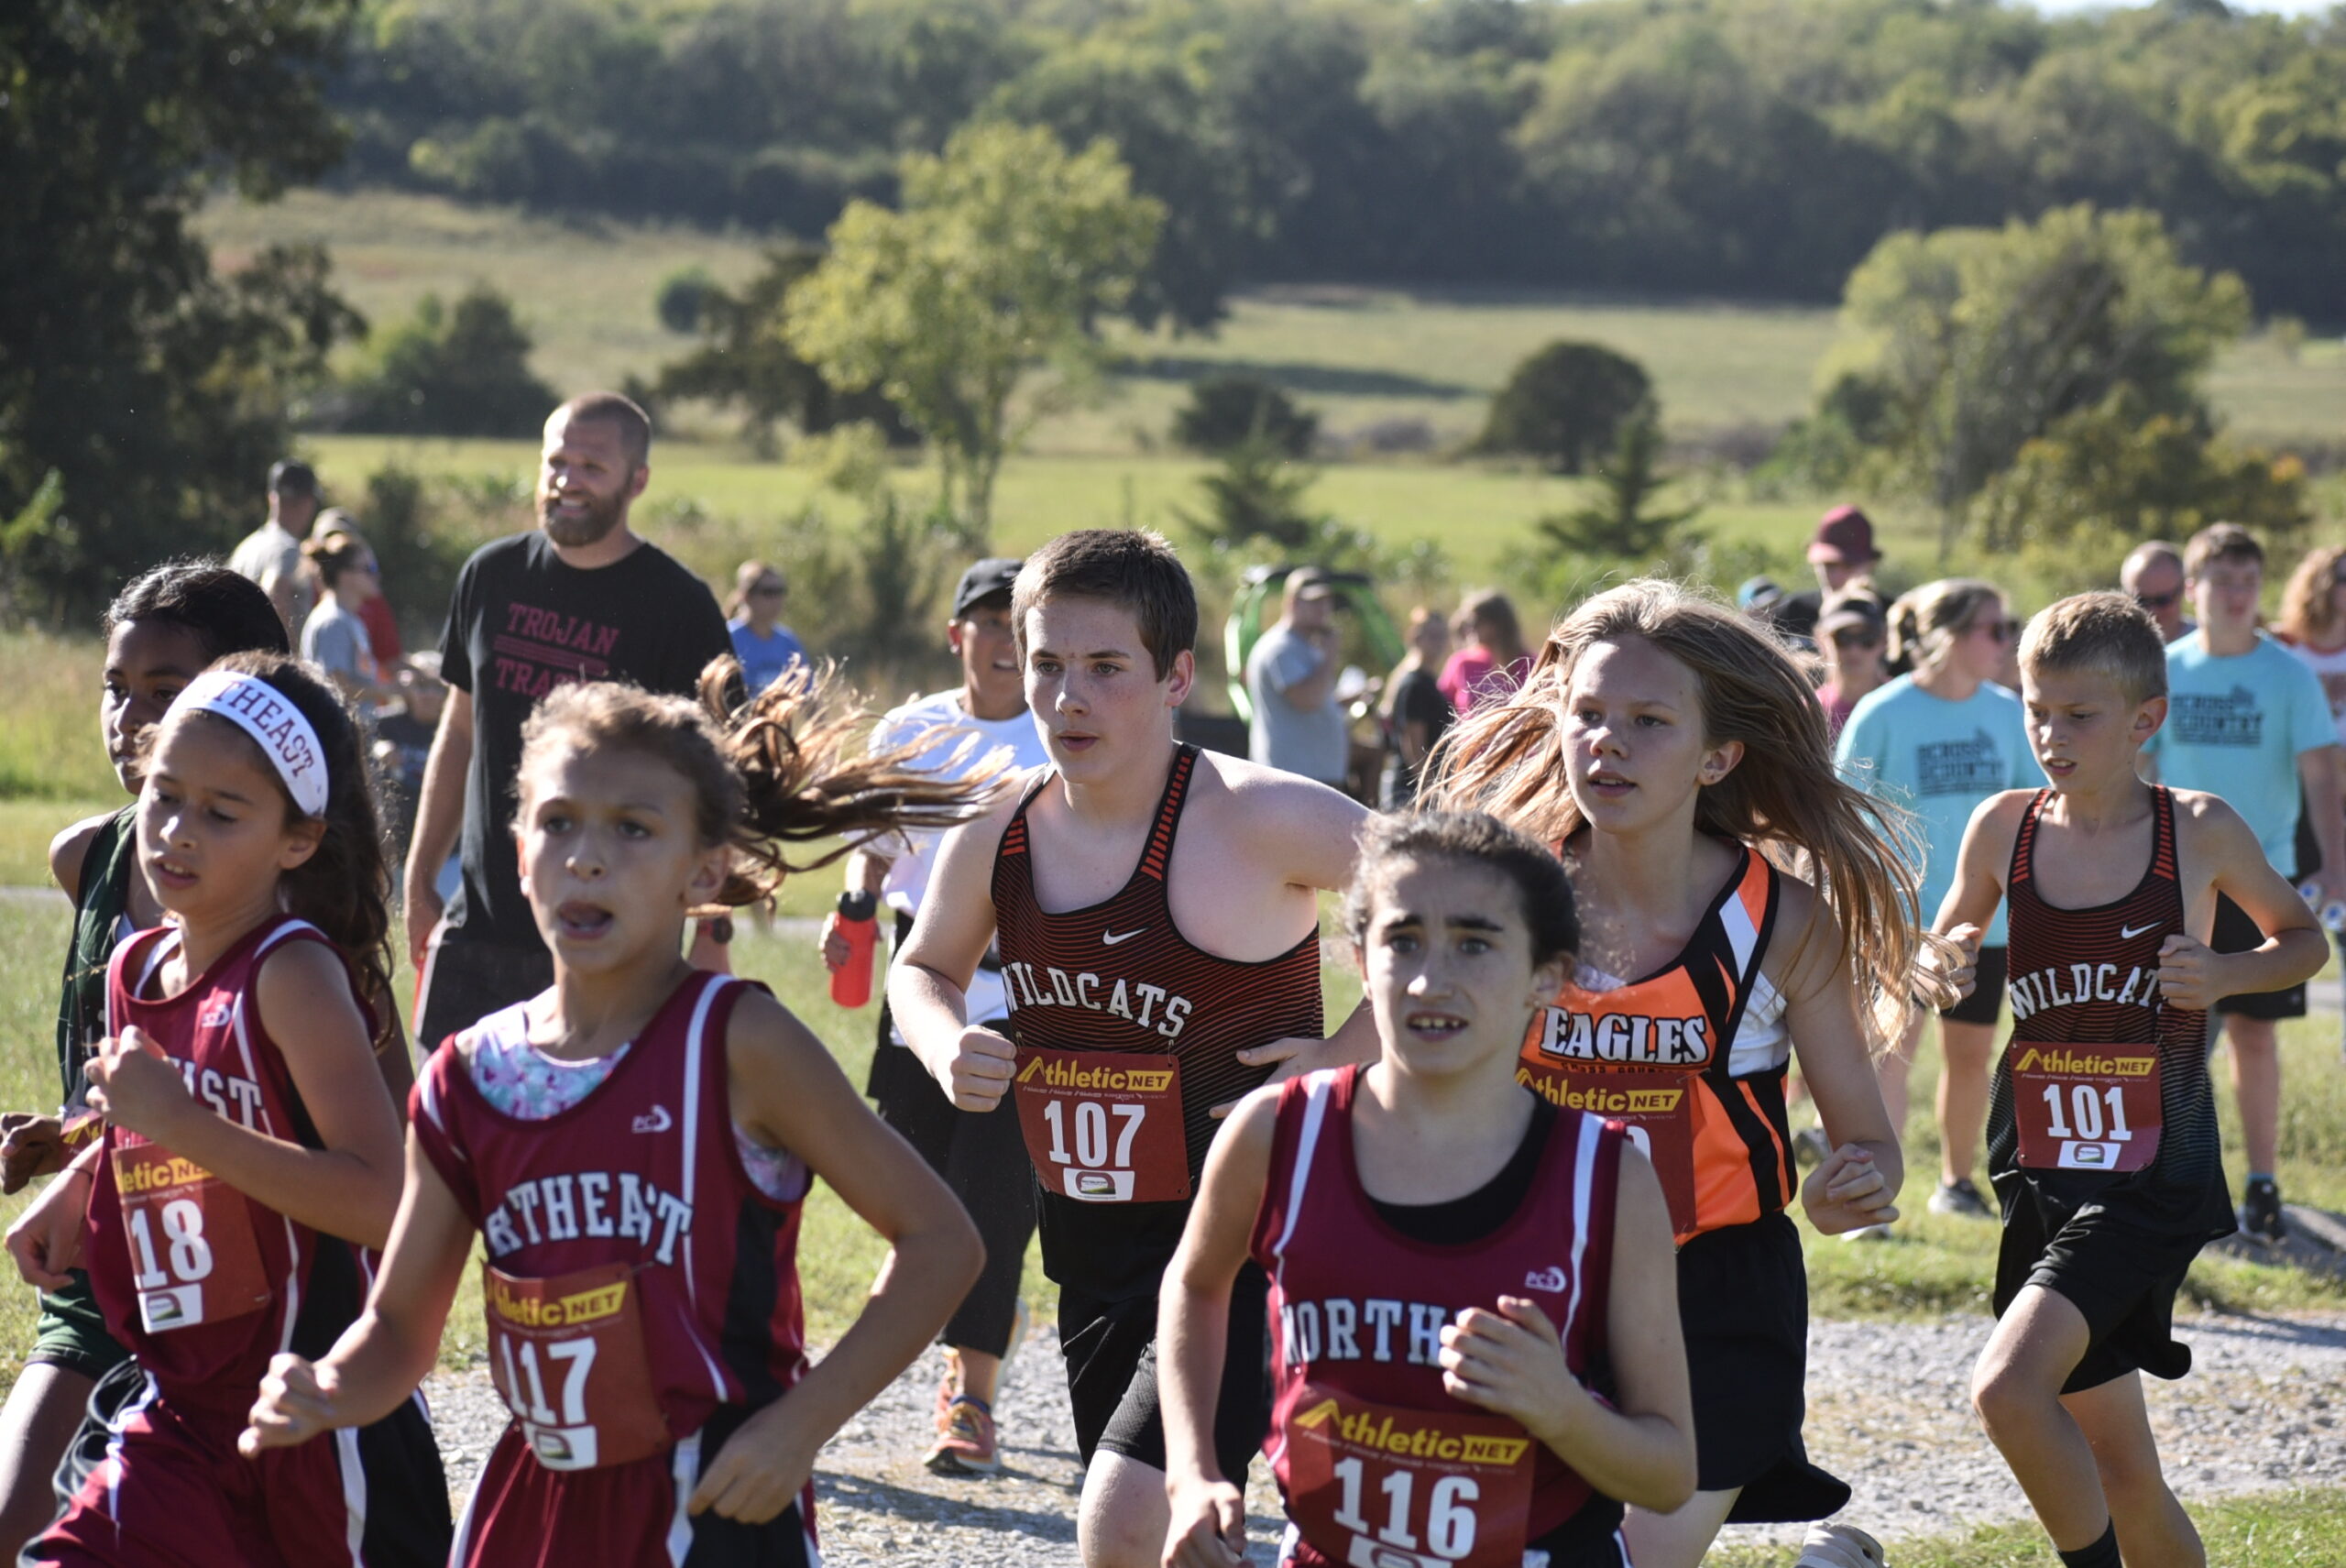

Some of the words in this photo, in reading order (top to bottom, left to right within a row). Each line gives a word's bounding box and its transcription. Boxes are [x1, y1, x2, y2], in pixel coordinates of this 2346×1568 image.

[508, 602, 620, 656] TROJAN
[203, 679, 315, 778] THEAST
[1000, 961, 1193, 1038] WILDCATS
[2008, 962, 2166, 1021] WILDCAT
[1540, 1003, 1711, 1067] EAGLES
[2014, 1047, 2115, 1075] Athletic
[2119, 1060, 2150, 1073] NET
[1016, 1056, 1127, 1090] Athletic
[1131, 1074, 1168, 1089] NET
[1632, 1093, 1675, 1109] NET
[1044, 1100, 1146, 1168] 107
[2043, 1084, 2132, 1142] 101
[116, 1160, 171, 1193] etic
[569, 1290, 619, 1317] NET
[1280, 1298, 1461, 1368] NORTH
[499, 1332, 597, 1426] 117
[1292, 1398, 1463, 1460] Athletic
[1467, 1441, 1519, 1459] NET
[1332, 1456, 1480, 1560] 116
